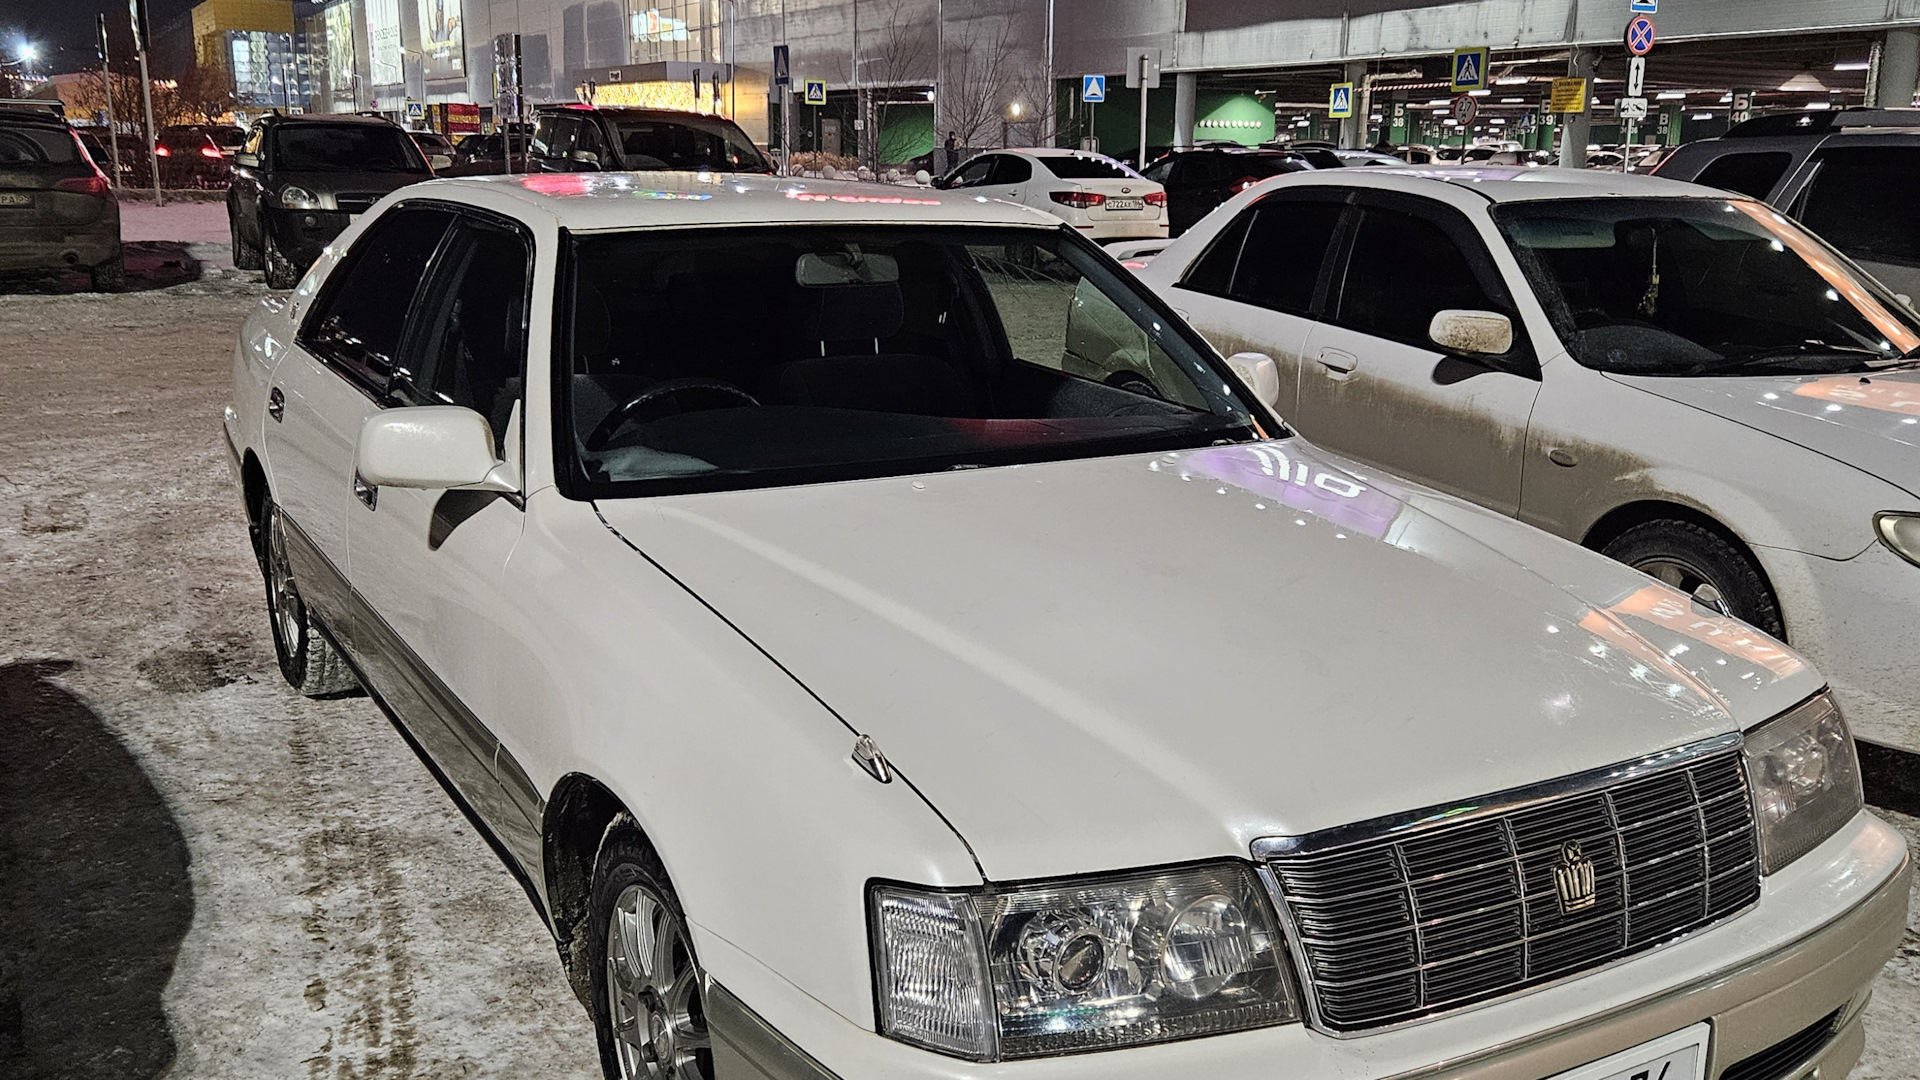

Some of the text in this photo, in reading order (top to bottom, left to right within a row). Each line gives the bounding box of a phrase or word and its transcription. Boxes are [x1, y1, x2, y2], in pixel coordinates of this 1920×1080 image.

[1733, 93, 1749, 110] Б
[1395, 103, 1404, 116] Б
[1392, 117, 1404, 128] 38
[1539, 114, 1554, 126] 39
[1659, 113, 1669, 125] В
[1731, 111, 1749, 123] 40
